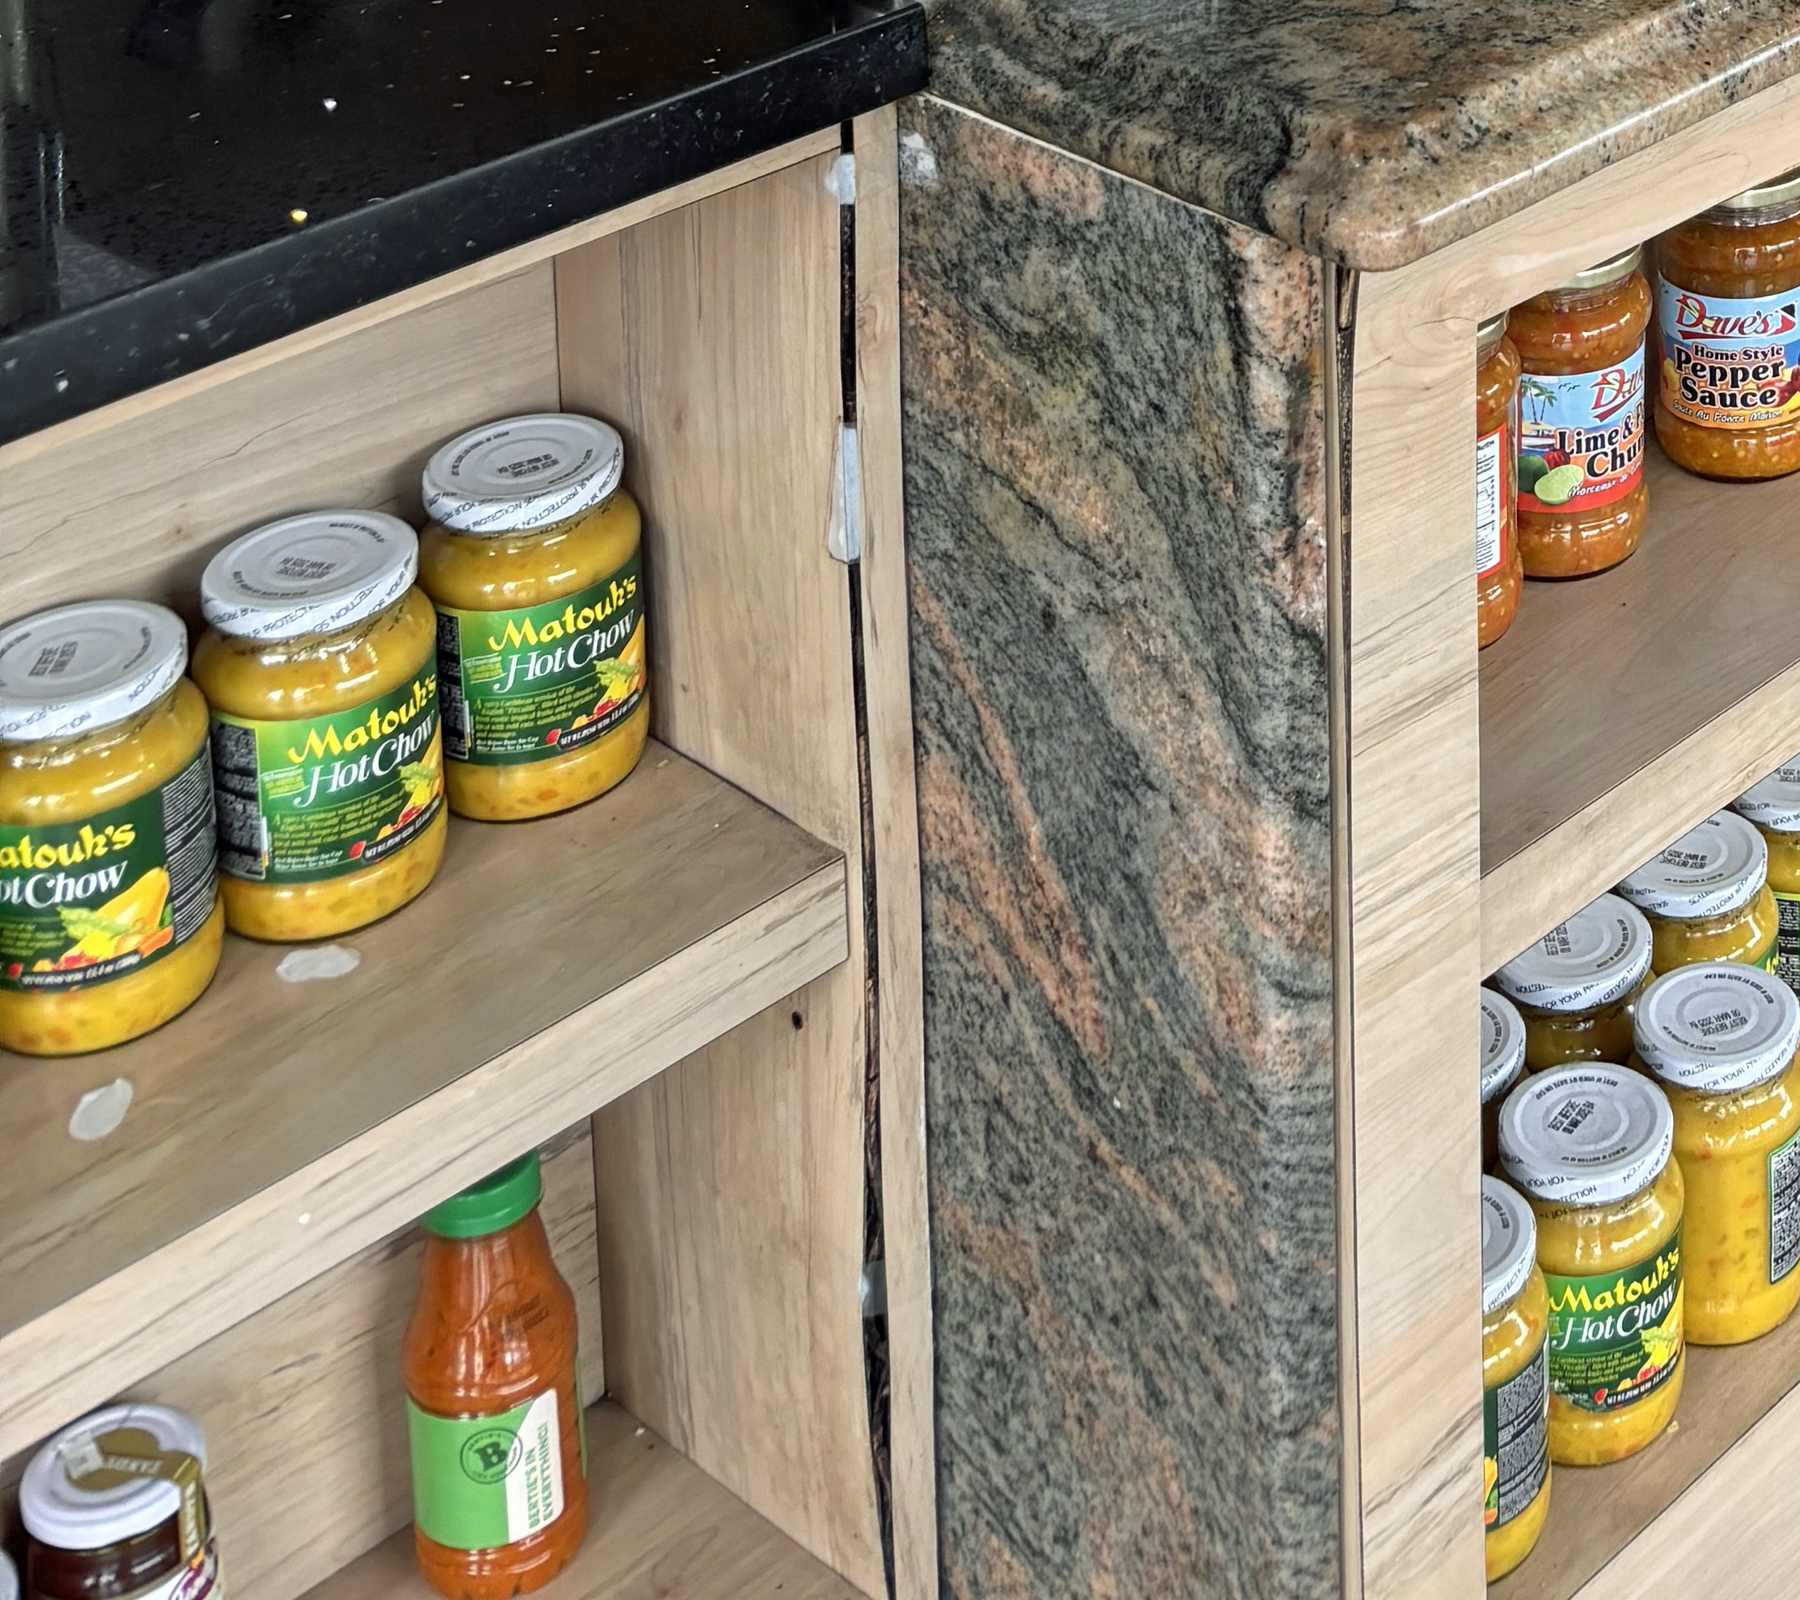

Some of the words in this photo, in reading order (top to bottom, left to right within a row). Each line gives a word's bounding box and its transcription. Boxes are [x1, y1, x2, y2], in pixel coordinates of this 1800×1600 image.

[1675, 294, 1773, 336] Dave's
[1675, 346, 1785, 388] Pepper
[1694, 344, 1738, 361] Home
[1742, 346, 1783, 362] Style
[1681, 376, 1778, 408] Sauce
[1557, 428, 1620, 455] Lime
[1623, 412, 1634, 440] &
[488, 575, 636, 651] Matouk's
[493, 649, 565, 693] Hot
[567, 609, 634, 669] Chow
[287, 674, 437, 764] Matouk's
[294, 754, 370, 808] Hot
[372, 709, 435, 777] Chow
[25, 860, 128, 909] Chow
[1559, 1185, 1597, 1202] TECTION
[1549, 1247, 1679, 1312] Matouk's
[1551, 1315, 1616, 1350] Hot
[1616, 1279, 1677, 1337] Chow
[525, 1448, 537, 1466] IN
[525, 1468, 541, 1529] BERTIE'S
